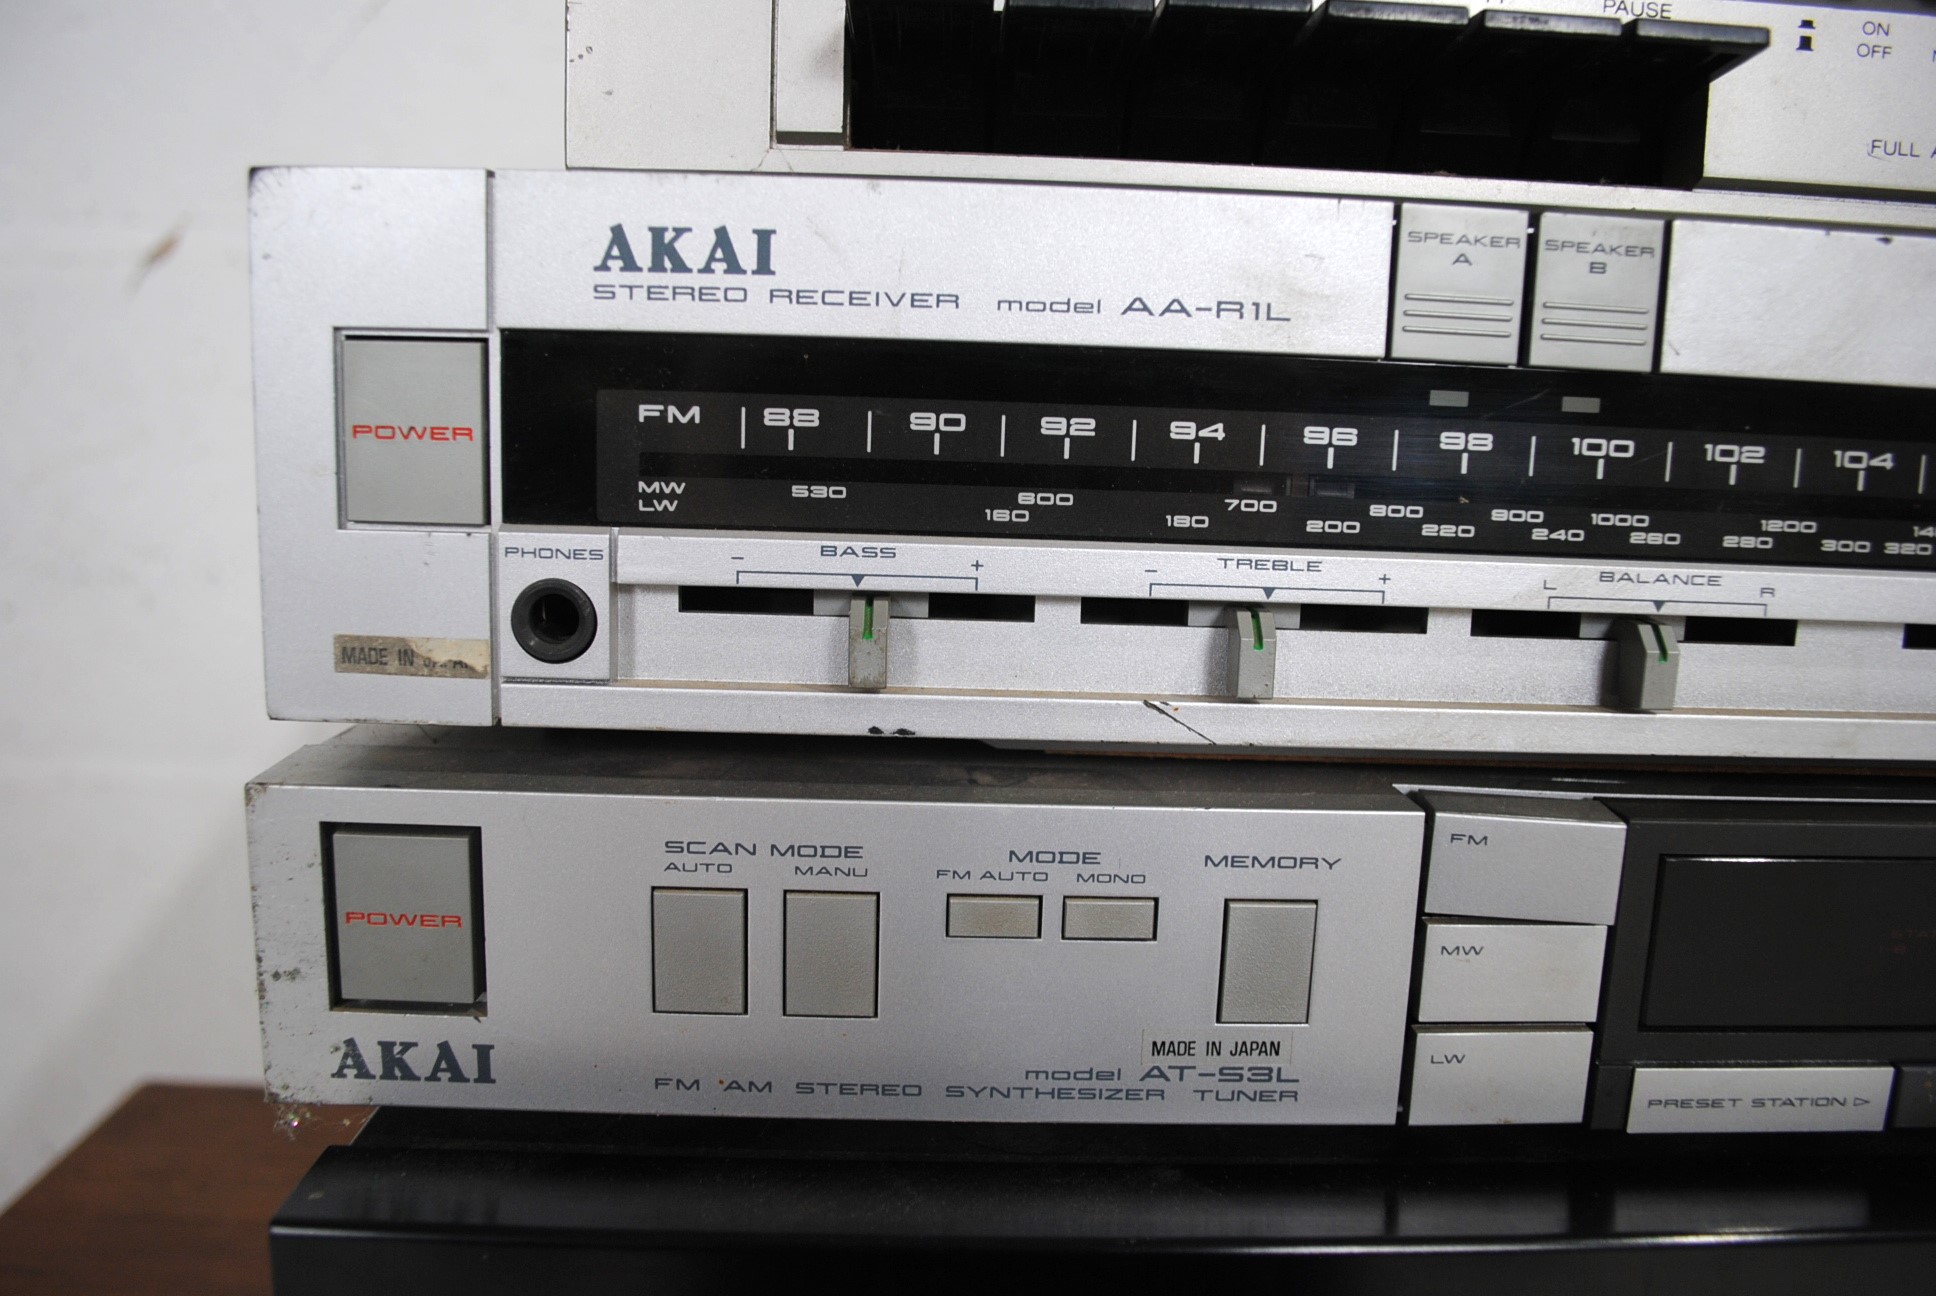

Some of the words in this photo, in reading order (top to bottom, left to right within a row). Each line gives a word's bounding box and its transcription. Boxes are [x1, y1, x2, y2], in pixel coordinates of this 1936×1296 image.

[1603, 0, 1673, 19] PAUSE
[1862, 20, 1891, 37] ON
[1856, 42, 1893, 59] OFF
[1871, 139, 1921, 158] FULL
[1407, 230, 1521, 249] SPEAKER
[1544, 238, 1656, 258] SPEAKER
[592, 223, 777, 276] AKAI
[1452, 252, 1473, 266] A
[1588, 261, 1608, 275] B
[592, 283, 748, 303] STEREO
[769, 288, 960, 310] RECEIVER
[996, 297, 1102, 314] model
[1120, 296, 1292, 322] AA-R1L
[352, 424, 475, 442] POWER
[638, 404, 701, 424] FM
[763, 407, 820, 427] 88
[909, 411, 967, 432] 90
[1040, 416, 1096, 436] 92
[1169, 420, 1226, 440] 94
[1303, 425, 1359, 446] 96
[1439, 431, 1494, 451] 98
[1571, 437, 1635, 458] 100
[1704, 443, 1766, 463] 102
[1833, 449, 1894, 470] 104
[638, 480, 686, 495] MW
[791, 484, 847, 499] 530
[1224, 498, 1278, 513] 700
[1369, 504, 1424, 519] 800
[1490, 508, 1545, 523] 900
[1590, 513, 1650, 528] 1000
[1760, 519, 1818, 534] 1200
[1913, 525, 1936, 538] 14
[638, 499, 678, 512] LW
[1165, 514, 1210, 529] 180
[1305, 519, 1361, 534] 200
[1421, 523, 1476, 538] 220
[1531, 527, 1585, 542] 240
[1722, 535, 1774, 549] 280
[1820, 539, 1871, 553] 300
[1883, 541, 1933, 556] 320
[504, 546, 604, 561] PHONES
[820, 545, 898, 559] BASS
[1218, 556, 1323, 573] TREBLE
[1542, 579, 1558, 591] L
[1598, 571, 1723, 588] BALANCE
[1759, 587, 1776, 598] R
[341, 646, 389, 667] MADE
[397, 648, 414, 667] IN
[1450, 833, 1489, 846] FM
[664, 840, 757, 856] SCAN
[770, 843, 864, 859] MODE
[1008, 849, 1102, 865] MODE
[664, 861, 733, 874] AUTO
[1204, 854, 1341, 870] MEMORY
[794, 865, 868, 878] MANU
[936, 869, 971, 880] FM
[979, 870, 1049, 882] AUTO
[1076, 872, 1146, 885] MONO
[345, 911, 464, 929] POWER
[1440, 945, 1484, 956] MW
[1151, 1040, 1197, 1057] MADE
[1205, 1040, 1222, 1057] IN
[1229, 1040, 1281, 1057] JAPAN
[330, 1037, 497, 1085] AKAI
[1430, 1054, 1466, 1065] LW
[1024, 1067, 1122, 1082] model
[654, 1077, 700, 1092] FM
[723, 1080, 773, 1093] AM
[795, 1081, 923, 1097] STEREO
[945, 1085, 1165, 1102] SYNTHESIZER
[1192, 1089, 1299, 1103] TUNER
[1647, 1098, 1743, 1110] PRESET
[1751, 1096, 1848, 1109] STATION
